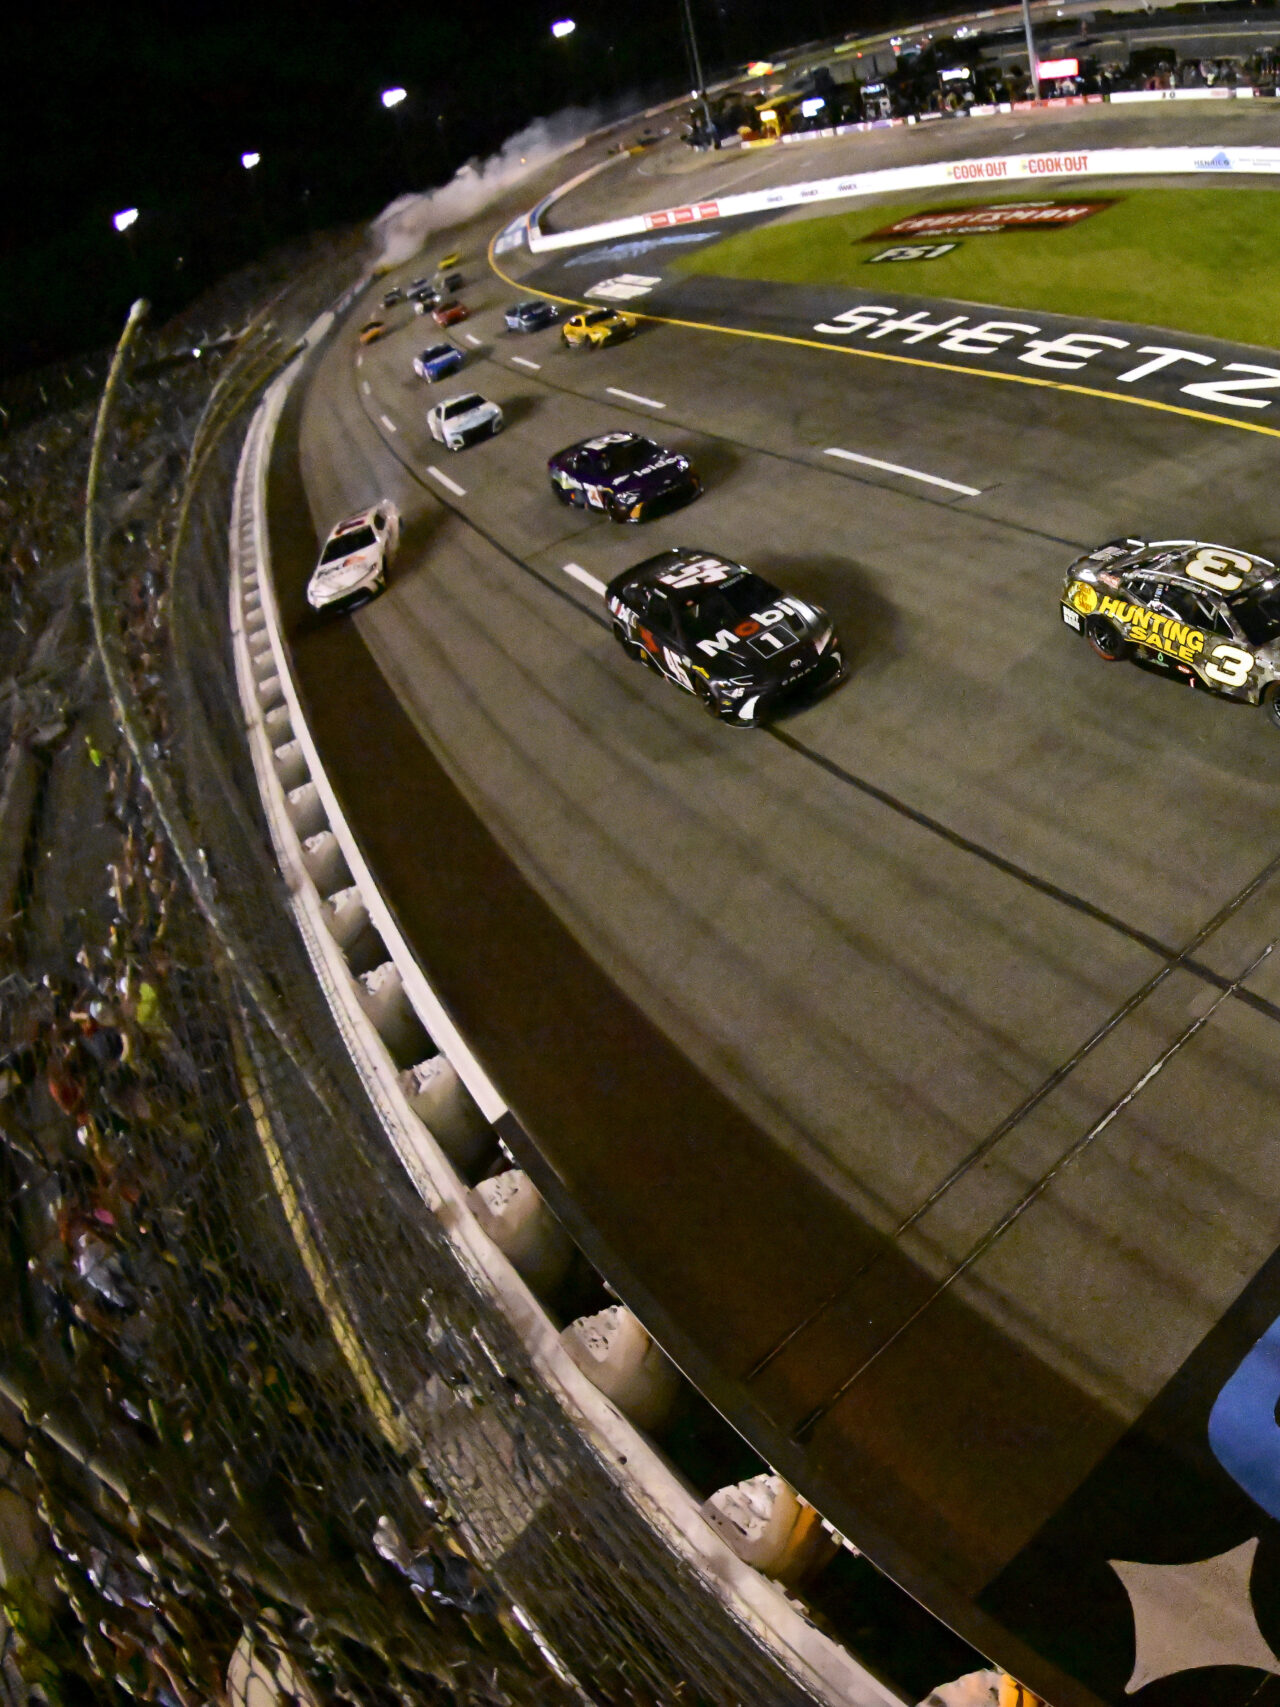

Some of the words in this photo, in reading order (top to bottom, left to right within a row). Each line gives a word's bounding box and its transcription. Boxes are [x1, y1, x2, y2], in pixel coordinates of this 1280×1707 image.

[1185, 548, 1253, 591] 3
[696, 597, 796, 658] Mobil
[759, 632, 784, 650] 1
[1098, 596, 1204, 653] HUNTING
[1129, 626, 1195, 663] SALE
[1204, 644, 1255, 687] 3
